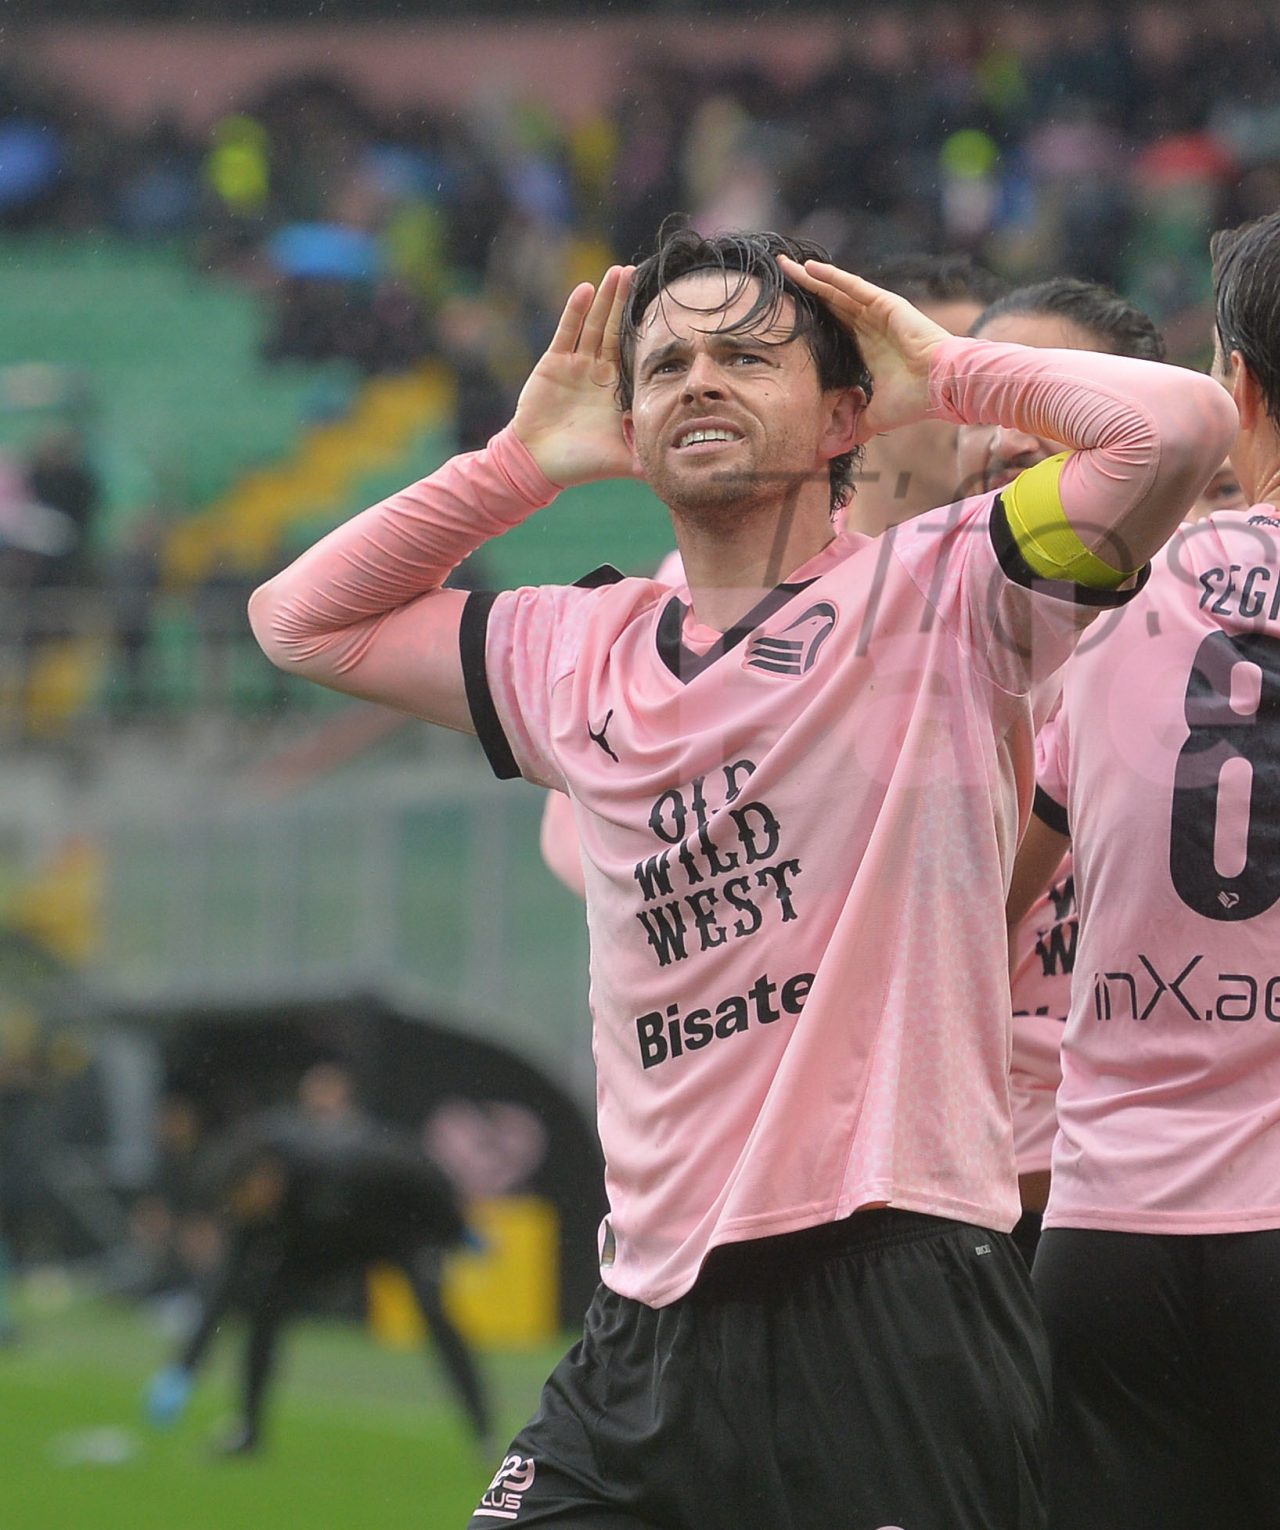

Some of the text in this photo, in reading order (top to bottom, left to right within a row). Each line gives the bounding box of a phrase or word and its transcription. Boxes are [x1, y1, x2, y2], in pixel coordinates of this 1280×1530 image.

[634, 801, 781, 902] WILD
[636, 858, 803, 967] WEST
[635, 971, 817, 1070] Bisate
[481, 1490, 523, 1511] LUS
